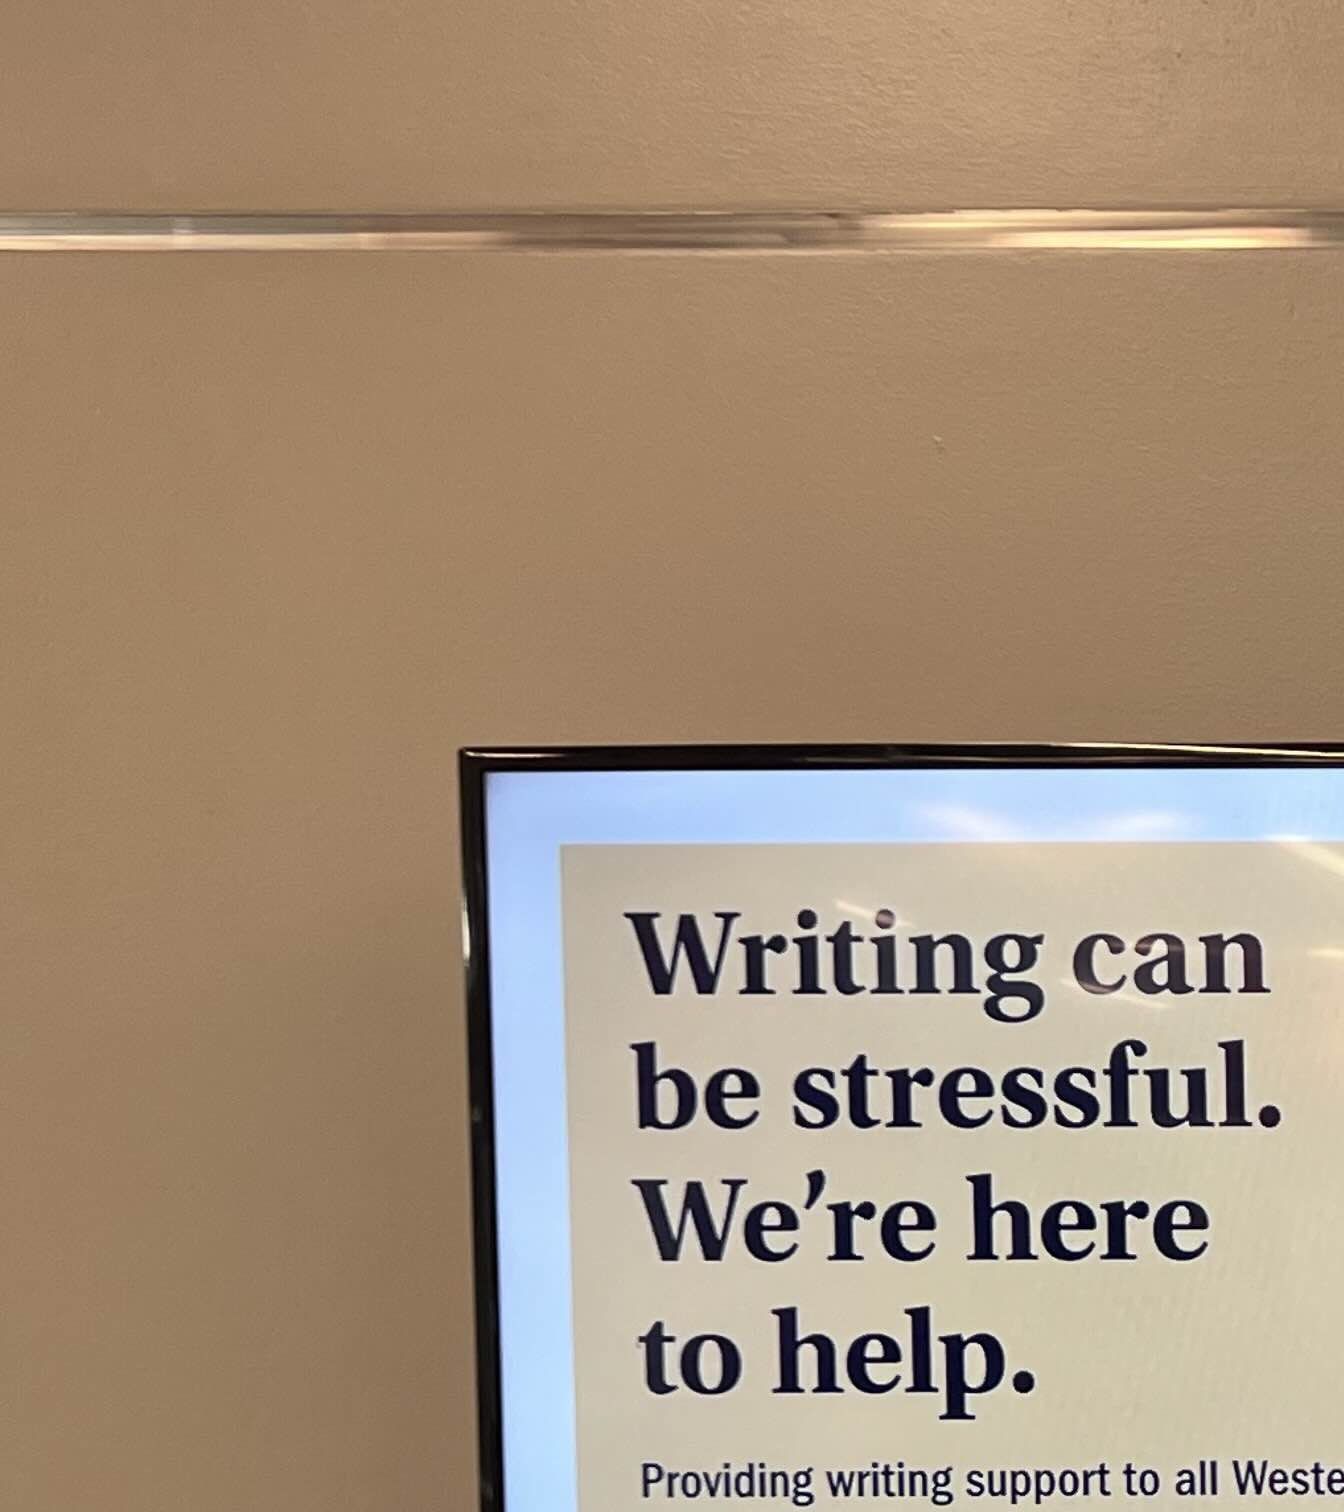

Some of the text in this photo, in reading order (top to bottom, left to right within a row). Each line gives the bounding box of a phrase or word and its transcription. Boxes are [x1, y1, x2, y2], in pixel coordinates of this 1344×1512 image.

[623, 909, 1271, 1023] Writing can
[630, 1040, 1280, 1130] be stressful.
[631, 1170, 1209, 1262] We're here
[638, 1306, 1034, 1420] to help.
[642, 1463, 814, 1506] Providing
[826, 1462, 953, 1506] writing
[966, 1463, 1111, 1504] support
[1123, 1463, 1159, 1496] to
[1176, 1461, 1217, 1495] all
